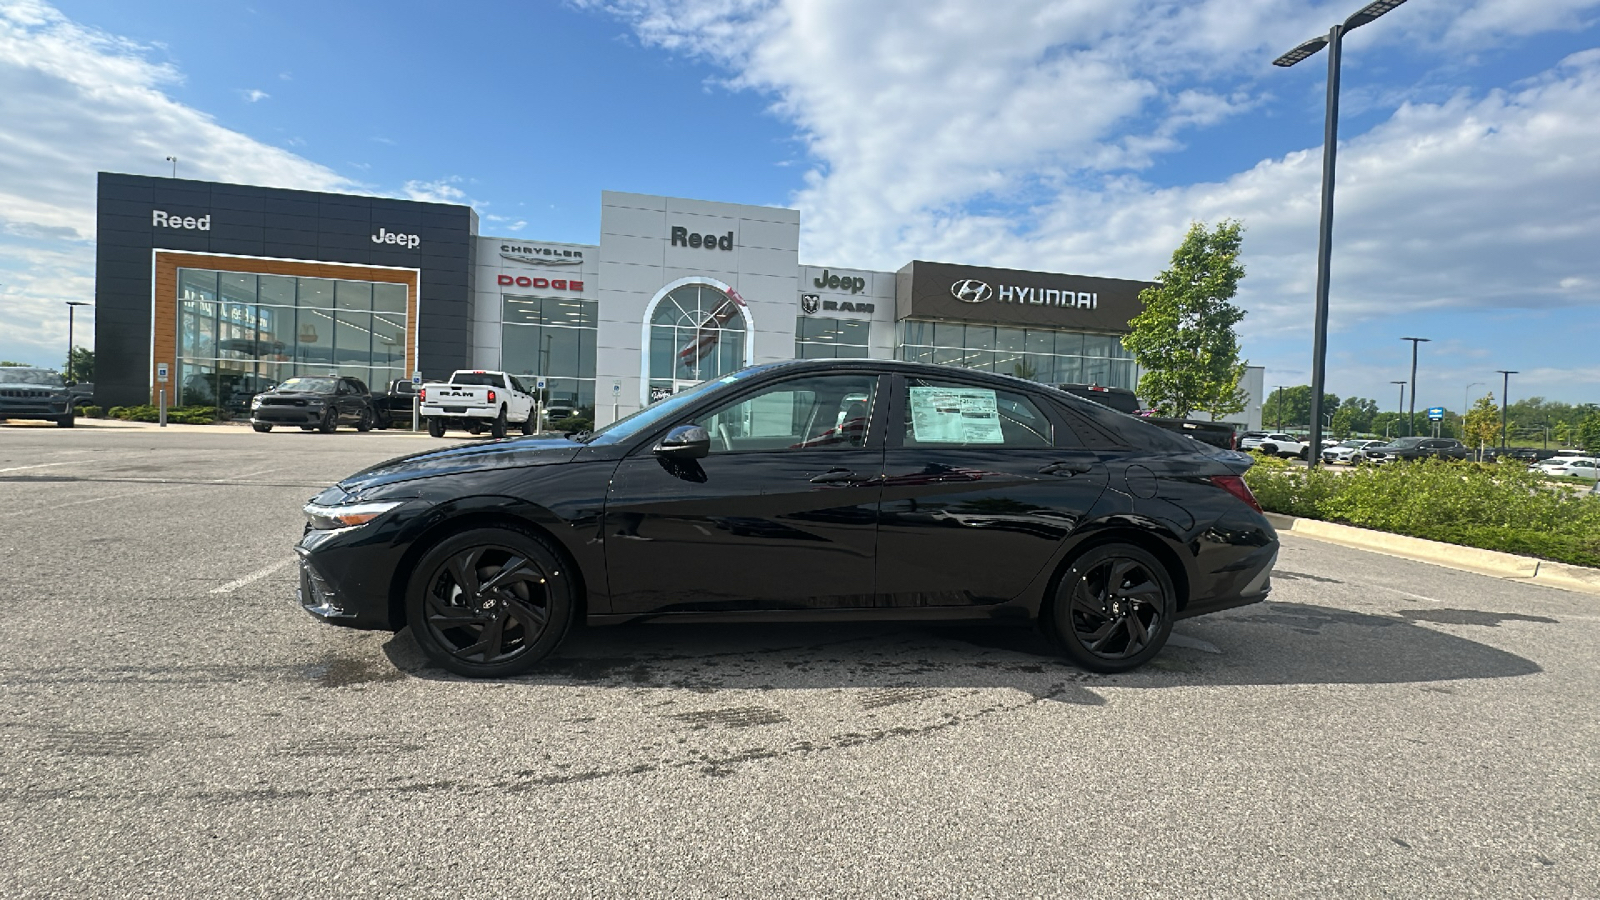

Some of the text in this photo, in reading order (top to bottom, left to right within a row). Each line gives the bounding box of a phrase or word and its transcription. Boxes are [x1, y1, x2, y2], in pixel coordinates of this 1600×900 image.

[152, 209, 211, 231] Reed
[371, 227, 421, 249] Jeep
[671, 225, 734, 251] Reed
[500, 244, 583, 259] CHRYSLER
[497, 274, 584, 292] DODGE
[813, 269, 866, 295] Jeep
[822, 300, 875, 314] RAM
[998, 284, 1098, 310] HYUNDAI
